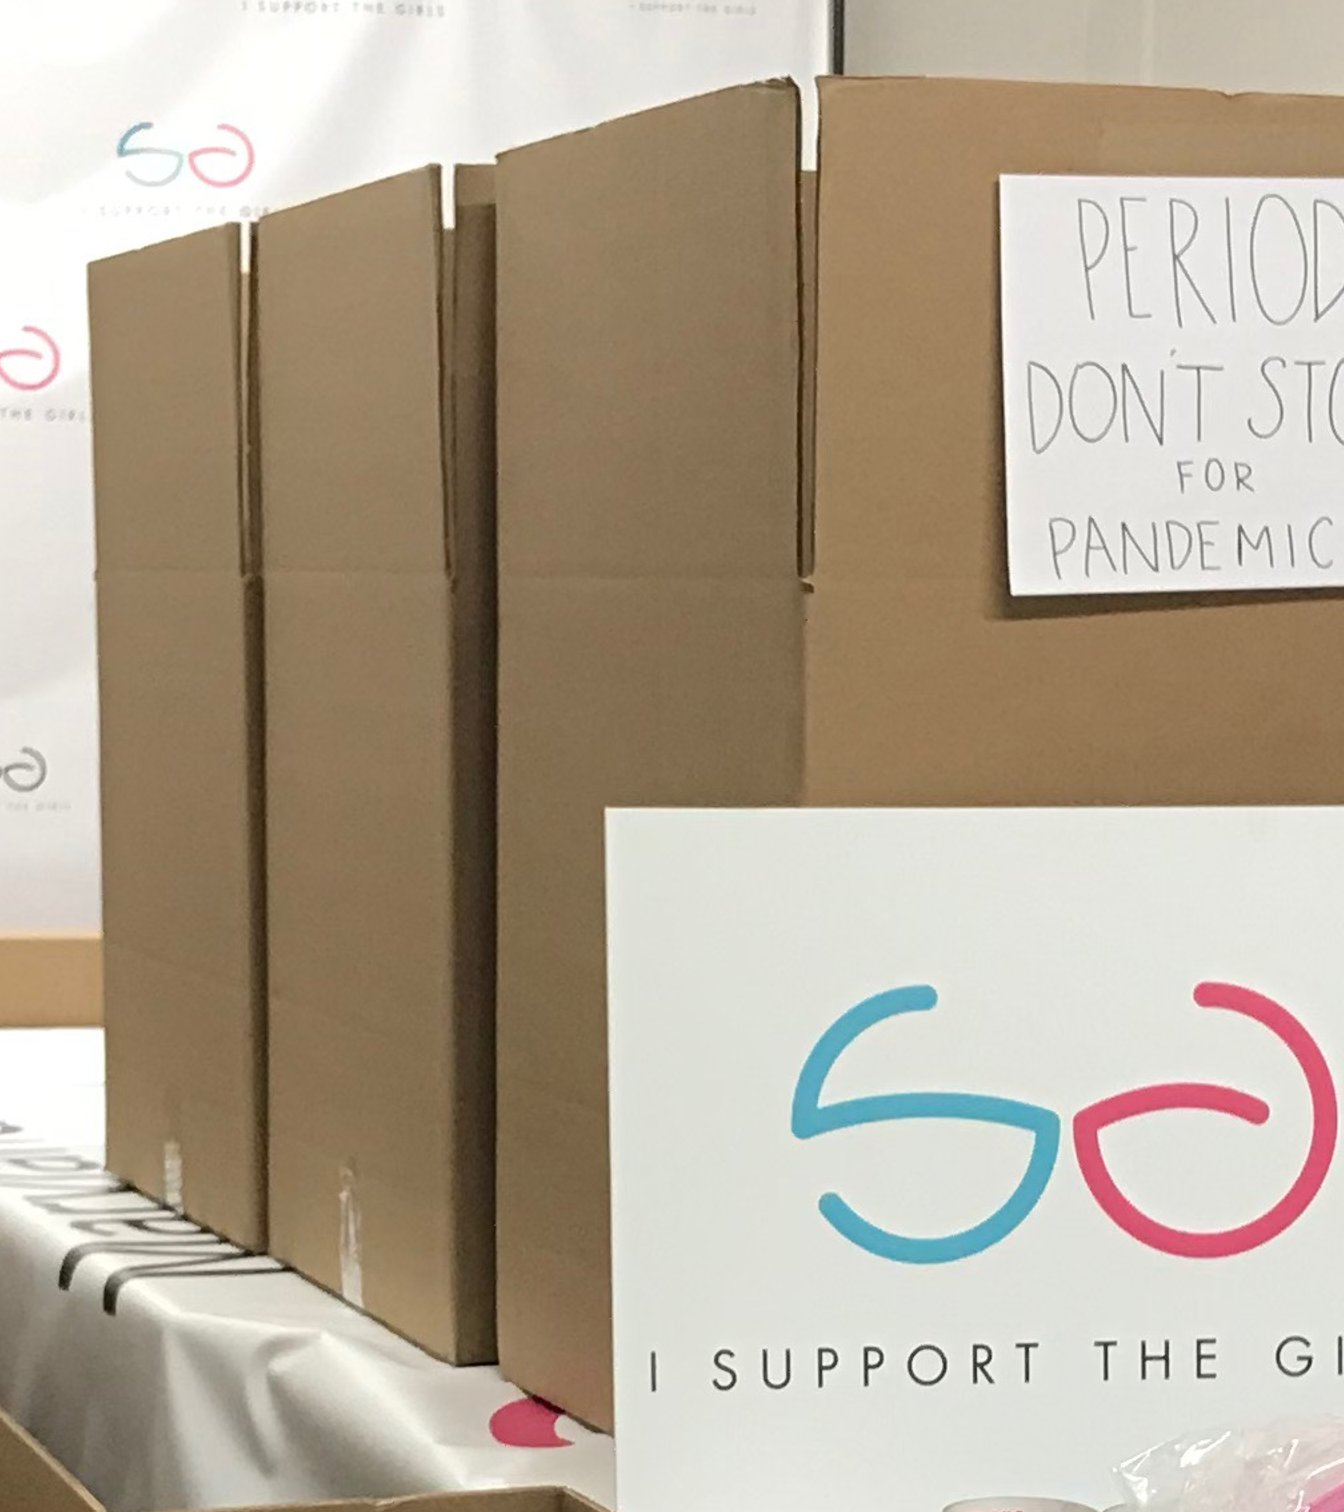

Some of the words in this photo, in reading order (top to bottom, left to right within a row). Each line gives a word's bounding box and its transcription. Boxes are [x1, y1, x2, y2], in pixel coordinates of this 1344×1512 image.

[44, 407, 85, 421] GIRL
[1026, 348, 1225, 454] DON'T
[1176, 458, 1255, 494] FOR
[649, 1350, 658, 1393] I
[712, 1342, 1039, 1392] SUPPORT
[1093, 1337, 1219, 1382] THE
